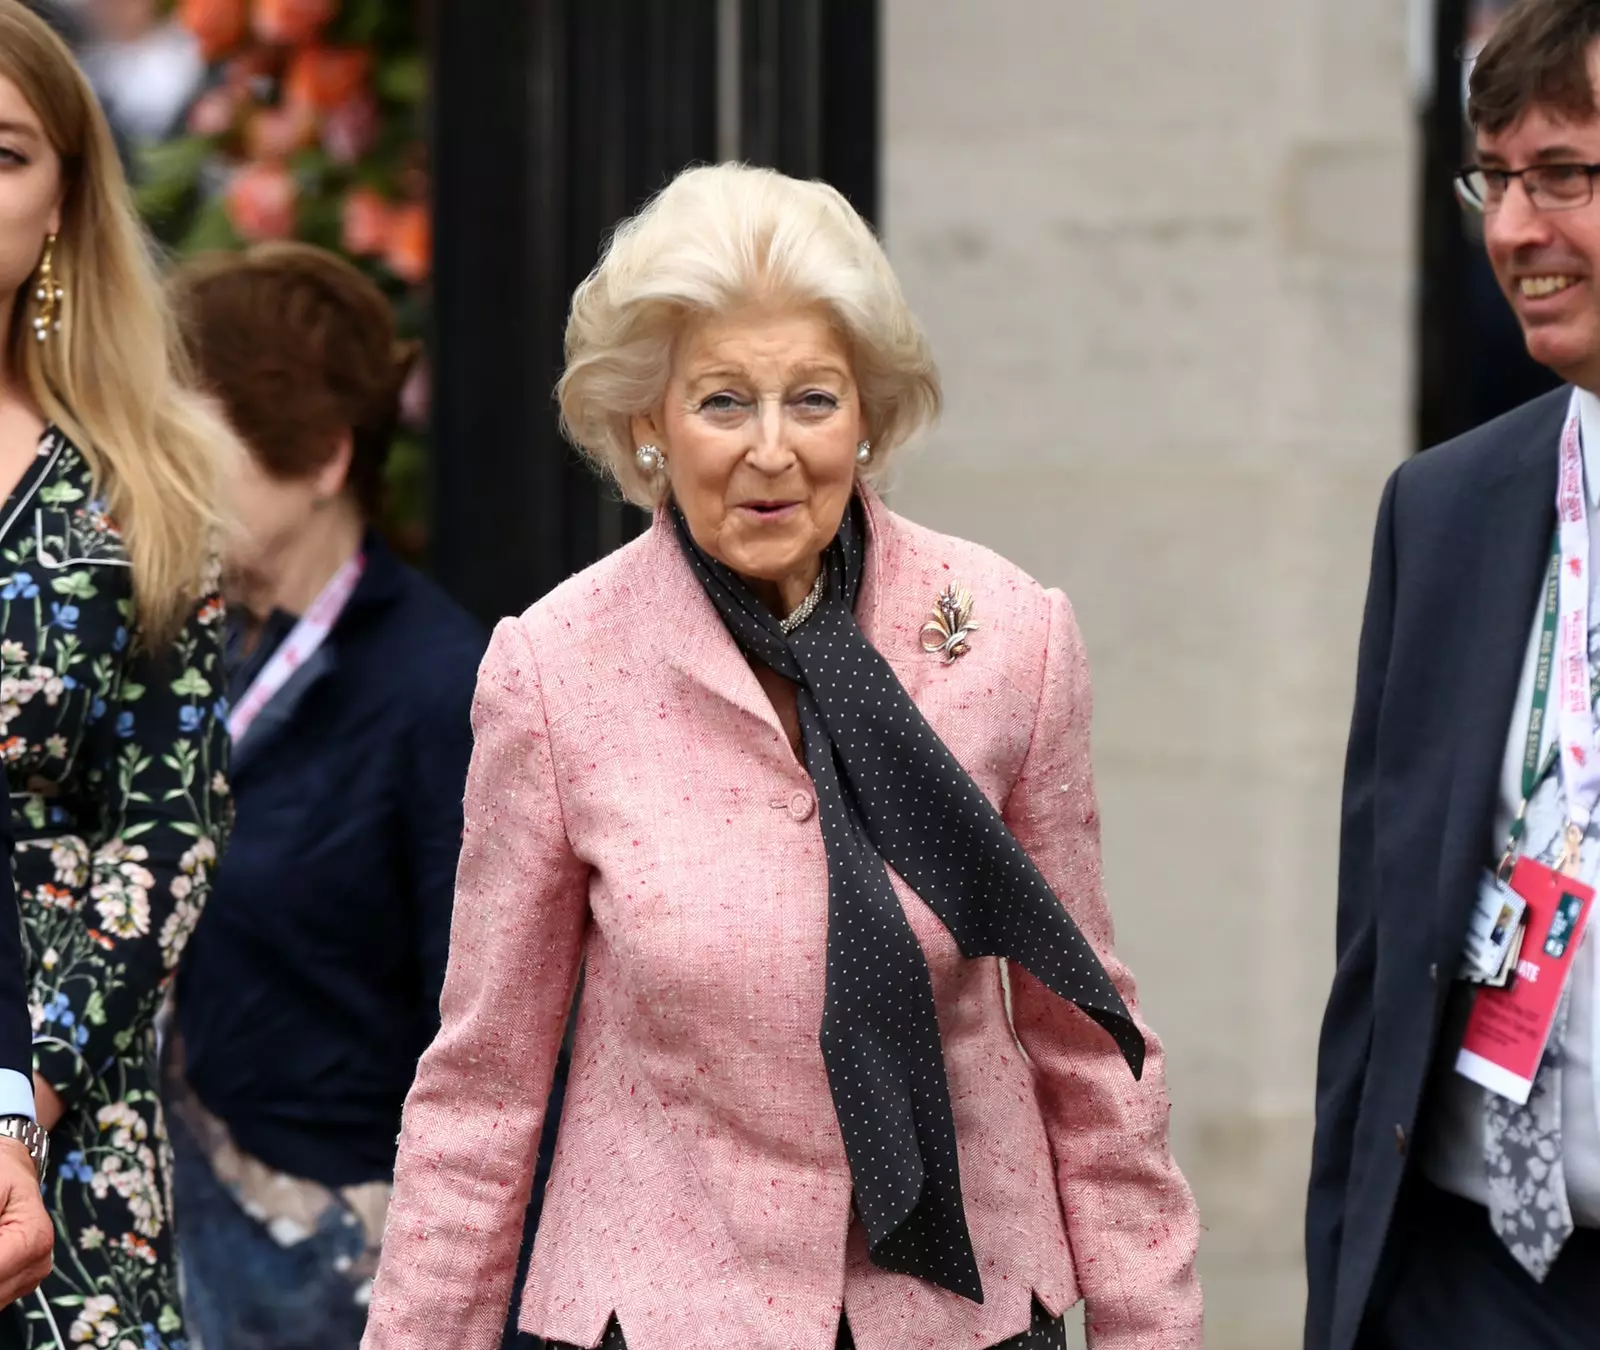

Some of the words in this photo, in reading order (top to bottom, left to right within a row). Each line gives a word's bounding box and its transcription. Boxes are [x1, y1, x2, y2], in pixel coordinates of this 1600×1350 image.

[1547, 580, 1558, 612] STAFF
[1541, 630, 1553, 655] RHS
[1537, 656, 1550, 689] STAFF
[1530, 708, 1543, 731] RHS
[1524, 733, 1539, 768] STAFF
